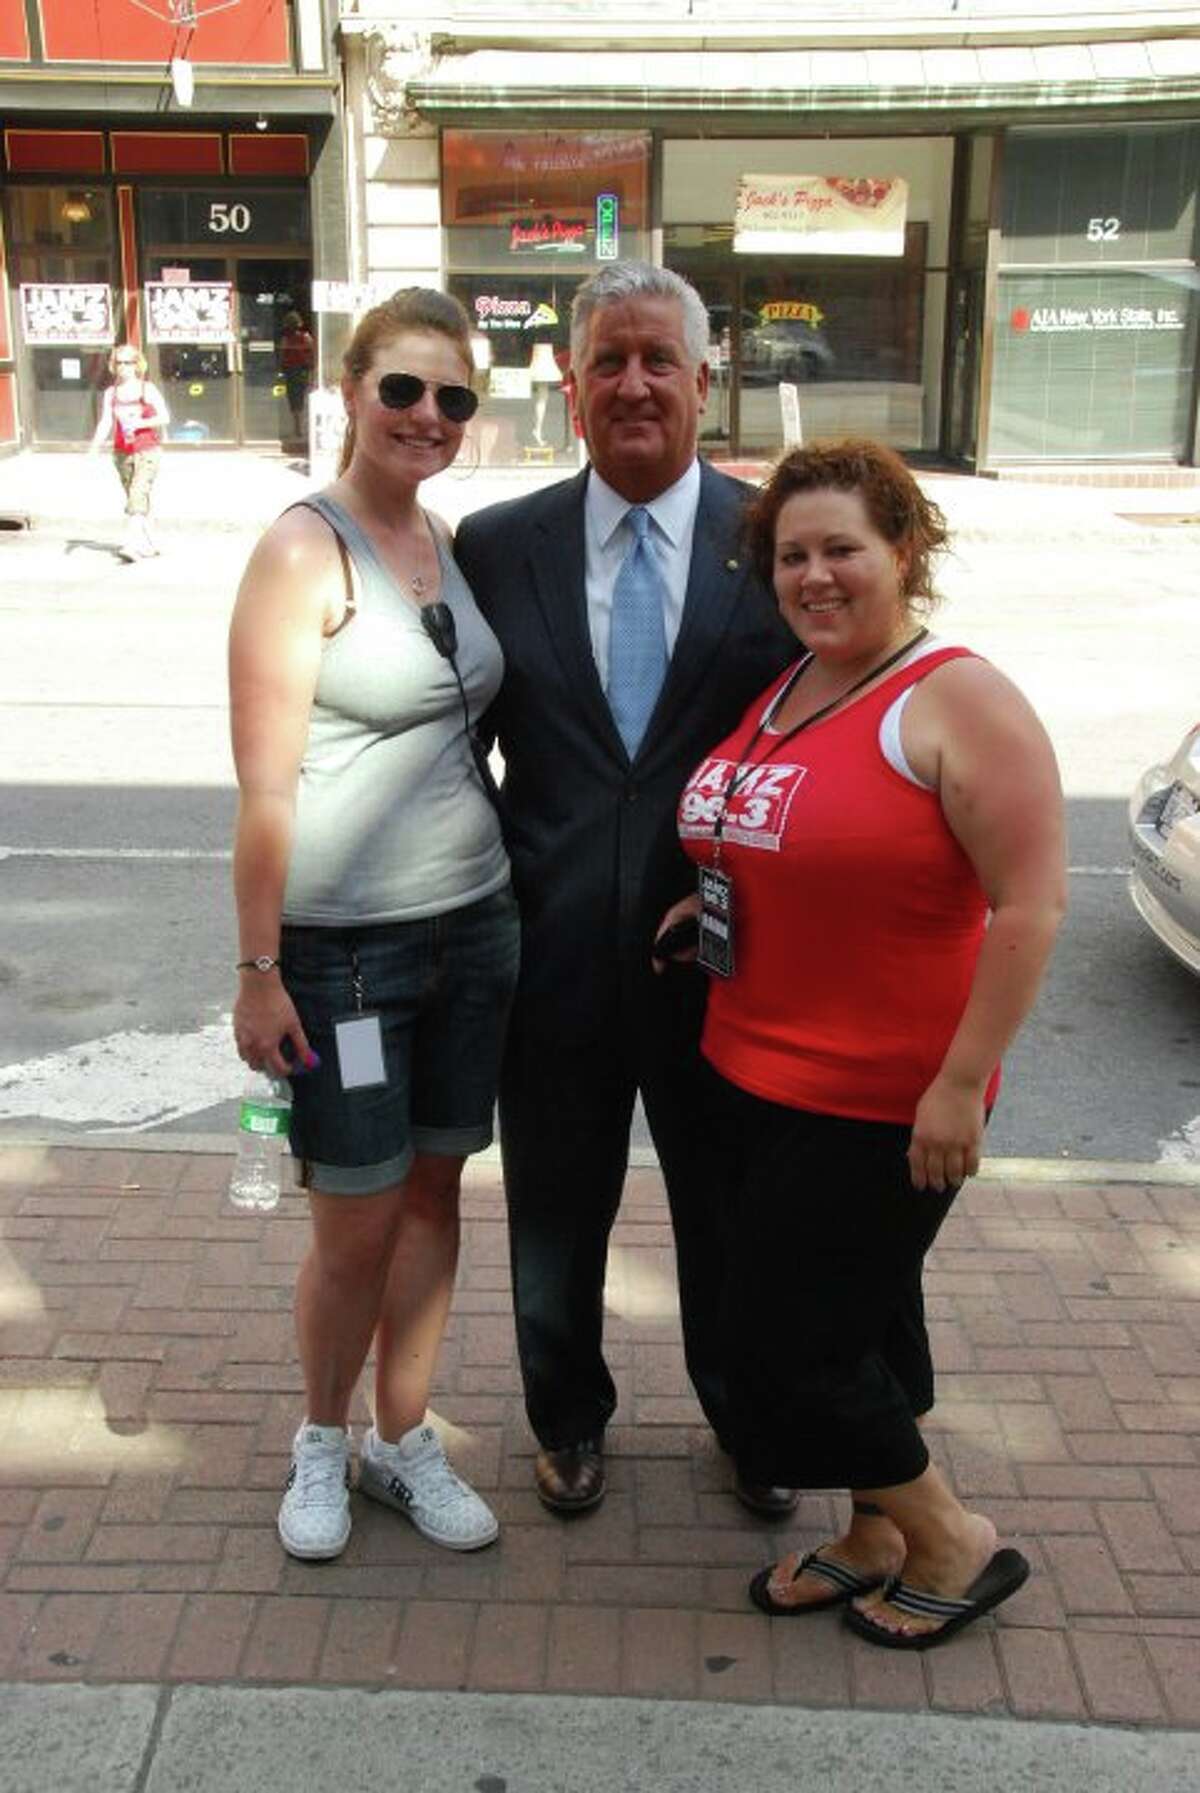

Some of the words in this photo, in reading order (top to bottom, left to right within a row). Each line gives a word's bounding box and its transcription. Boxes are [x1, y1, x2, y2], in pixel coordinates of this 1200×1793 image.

[744, 191, 787, 212] Jack's
[794, 190, 833, 213] Pizza
[209, 203, 251, 232] 50
[1087, 218, 1120, 241] 52
[1059, 308, 1088, 324] New
[1090, 308, 1118, 324] York
